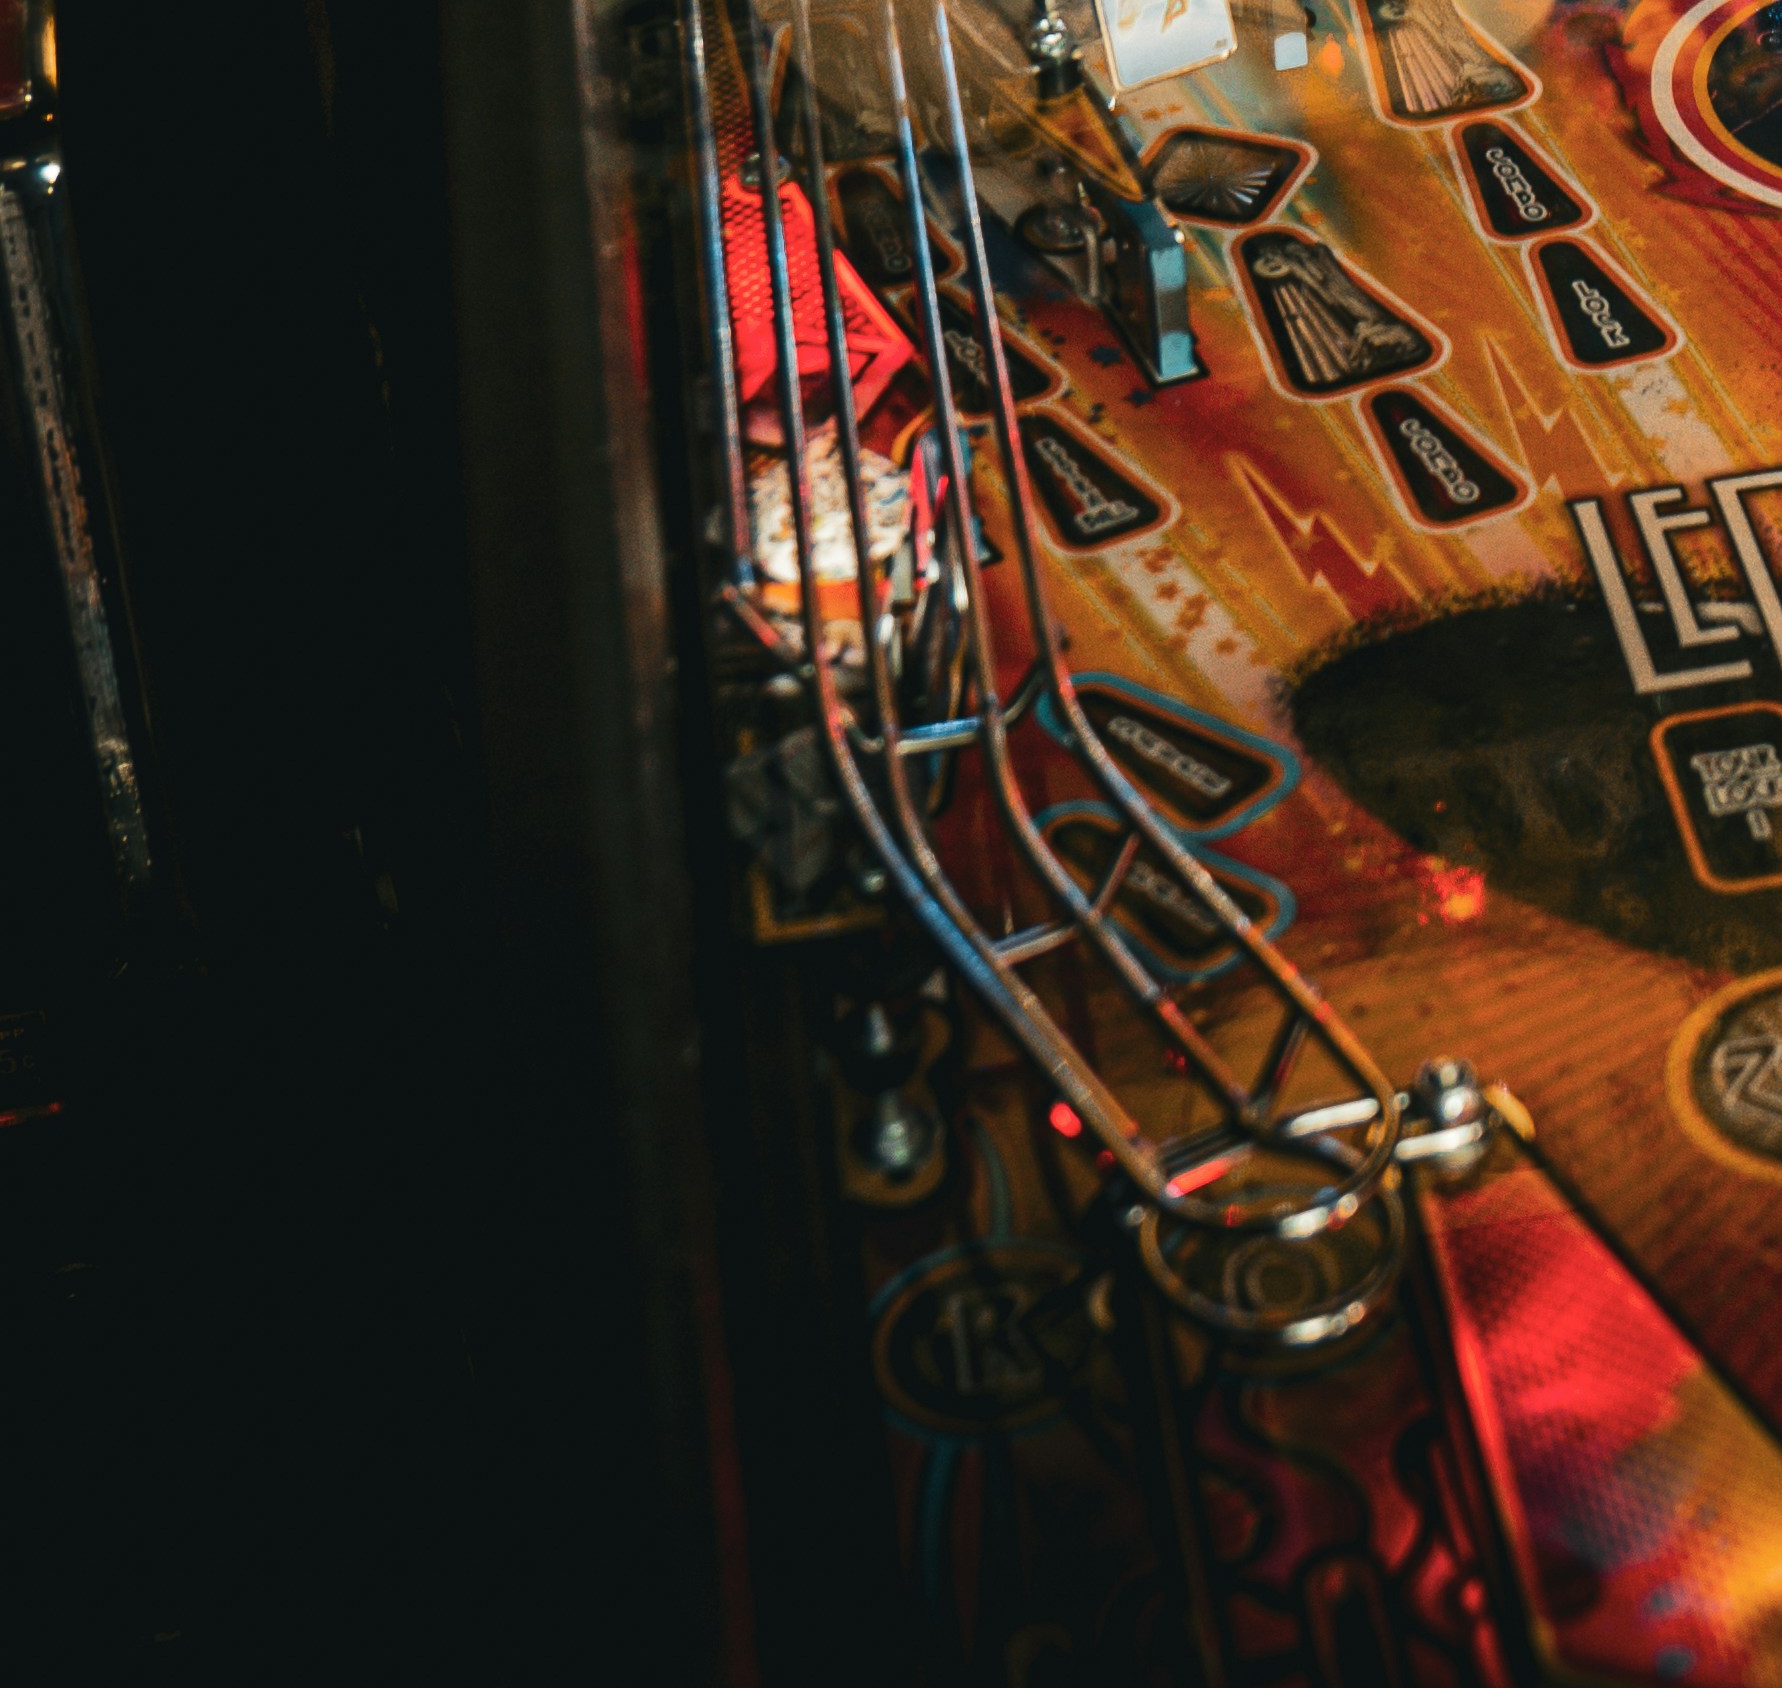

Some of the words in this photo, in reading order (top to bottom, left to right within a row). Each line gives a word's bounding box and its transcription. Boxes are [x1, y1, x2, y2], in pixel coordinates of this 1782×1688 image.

[1486, 147, 1547, 222] COMBO
[1572, 279, 1631, 349] LOCK
[1400, 418, 1481, 504] COMBO
[1746, 809, 1773, 841] 1
